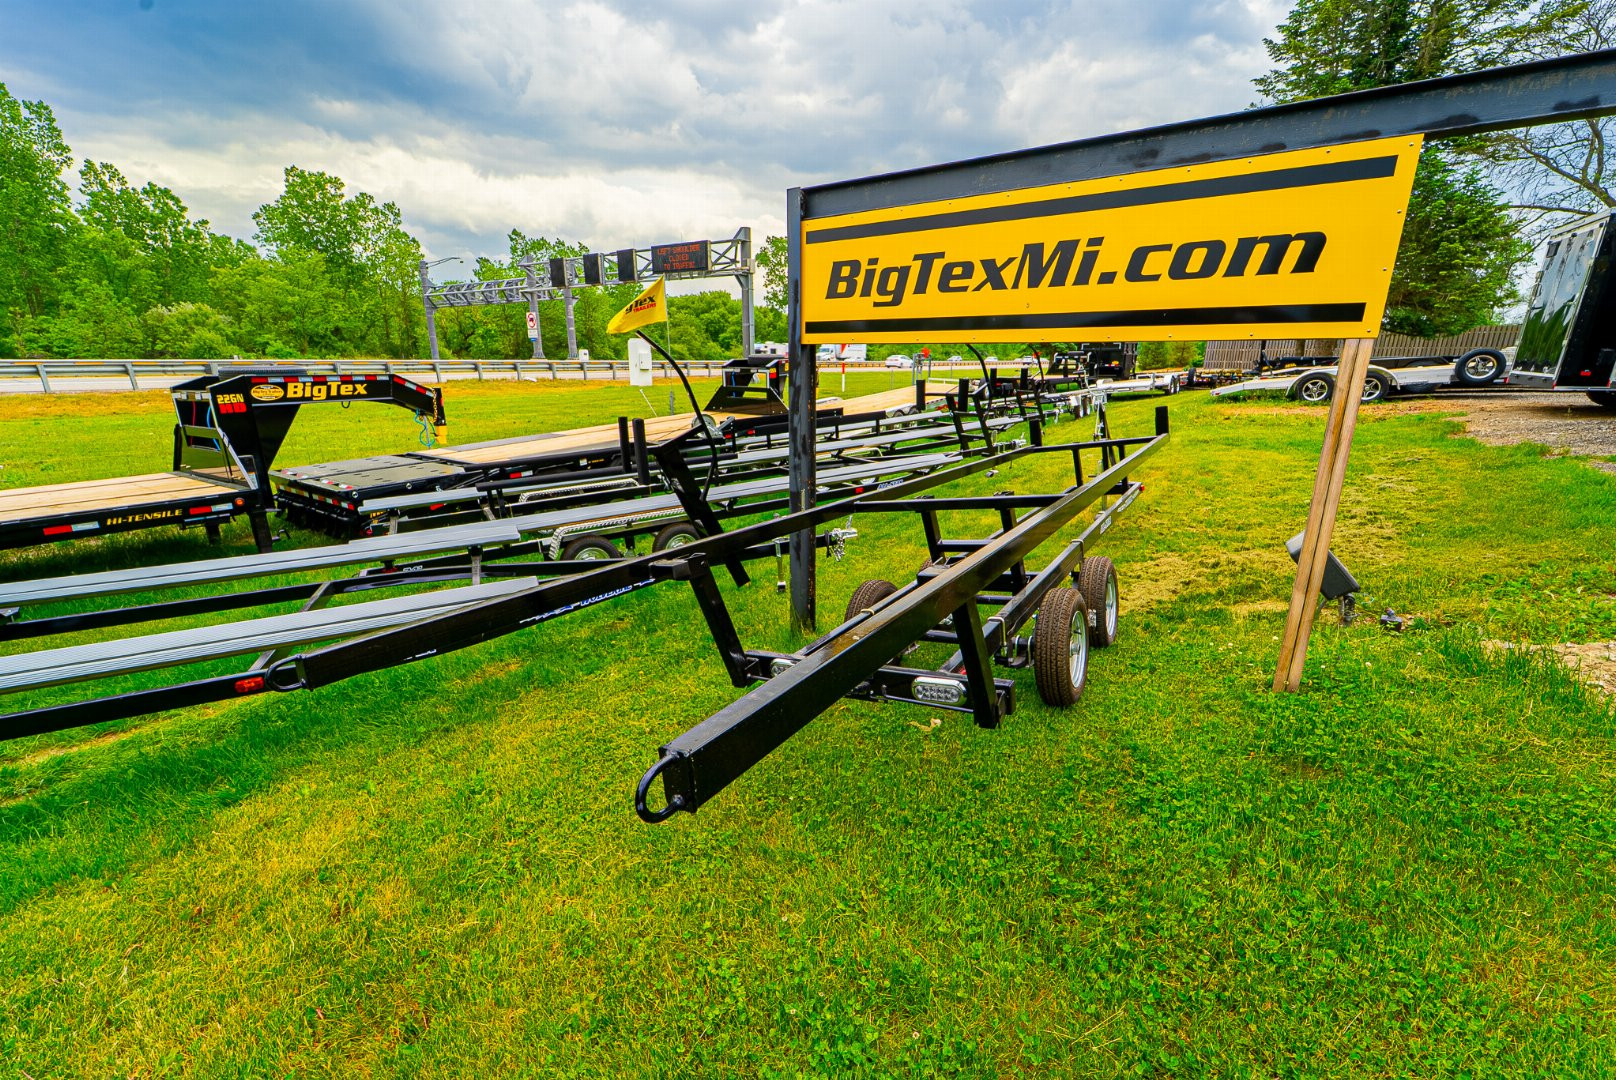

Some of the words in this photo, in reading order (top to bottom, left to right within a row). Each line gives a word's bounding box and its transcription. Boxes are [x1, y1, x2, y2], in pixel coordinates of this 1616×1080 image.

[825, 231, 1328, 308] BigTexMi.com
[633, 302, 656, 312] TRAILERS
[286, 381, 368, 401] BigTex
[219, 402, 247, 415] HD
[107, 509, 183, 526] HI-TENSILE
